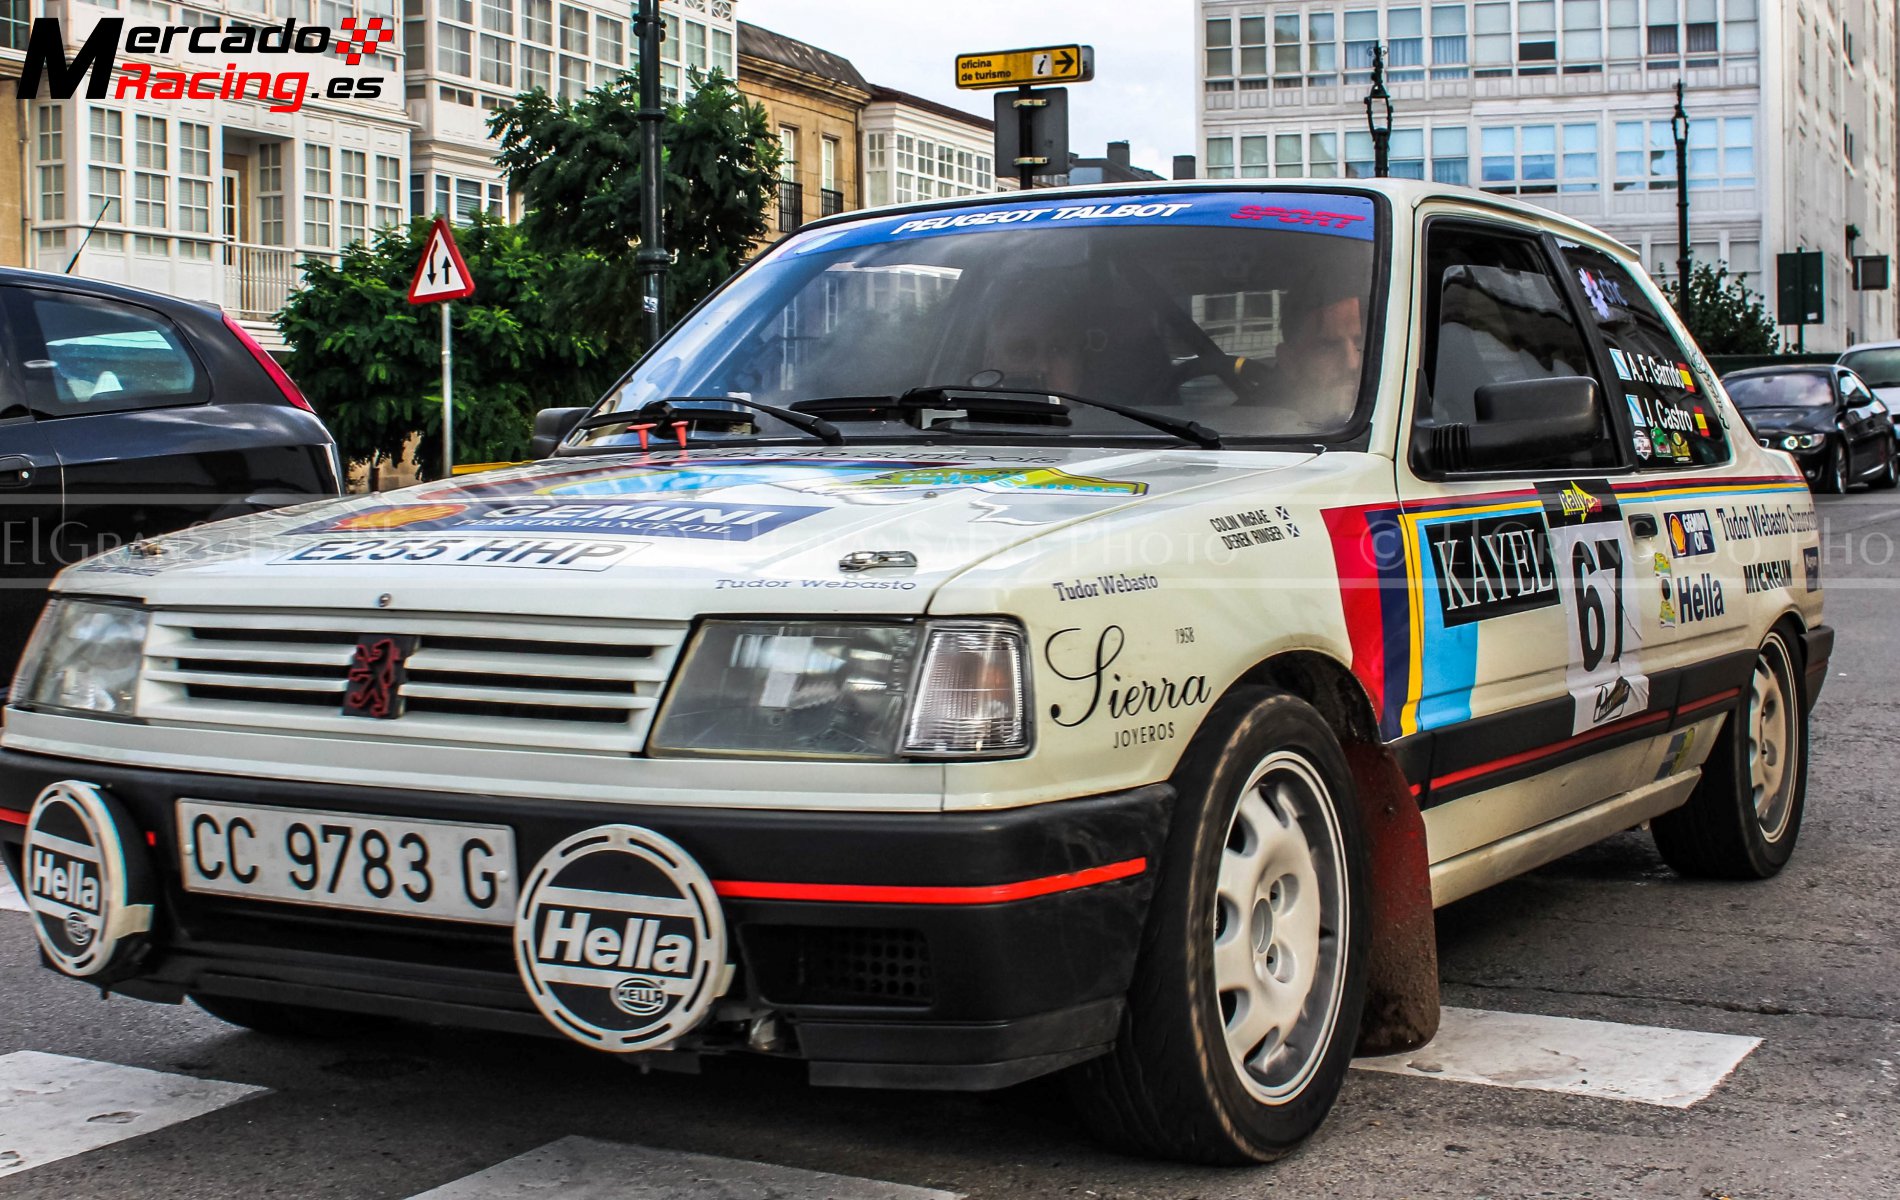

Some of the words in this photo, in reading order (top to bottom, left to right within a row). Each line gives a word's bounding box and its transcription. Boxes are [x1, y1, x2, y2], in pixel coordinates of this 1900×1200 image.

[961, 59, 992, 69] oficina
[961, 73, 973, 81] de
[975, 70, 1012, 80] turismo
[890, 208, 1048, 235] PEUGEOT
[1051, 203, 1193, 221] TALBOT
[1229, 204, 1366, 229] SPORT
[1647, 355, 1685, 389] Garrido
[1655, 399, 1693, 432] Castro
[453, 518, 670, 531] PERFORMANCE
[678, 523, 731, 534] OIL
[483, 504, 783, 525] GEMINI
[1209, 515, 1241, 532] COLIN
[1716, 506, 1751, 541] Tudor
[1746, 504, 1789, 537] Webasto
[287, 540, 466, 562] E255
[456, 539, 627, 564] HHP
[1221, 532, 1255, 550] DEREK
[1249, 526, 1285, 544] RINGER
[715, 578, 795, 590] Tudor
[800, 577, 917, 591] Webasto
[1434, 529, 1554, 611] KAYEL
[1743, 560, 1793, 595] MICHELIN
[1053, 579, 1098, 601] Tudor
[1097, 574, 1159, 596] Webasto
[1677, 573, 1725, 624] Hella
[1571, 538, 1624, 673] 67
[1045, 624, 1212, 727] Sierra
[1113, 722, 1175, 749] JOYEROS
[192, 813, 259, 884] CC
[285, 822, 433, 903] 9783
[460, 836, 498, 909] G
[33, 850, 100, 911] Hella
[538, 909, 694, 974] Hella
[618, 986, 665, 1006] HELLA
